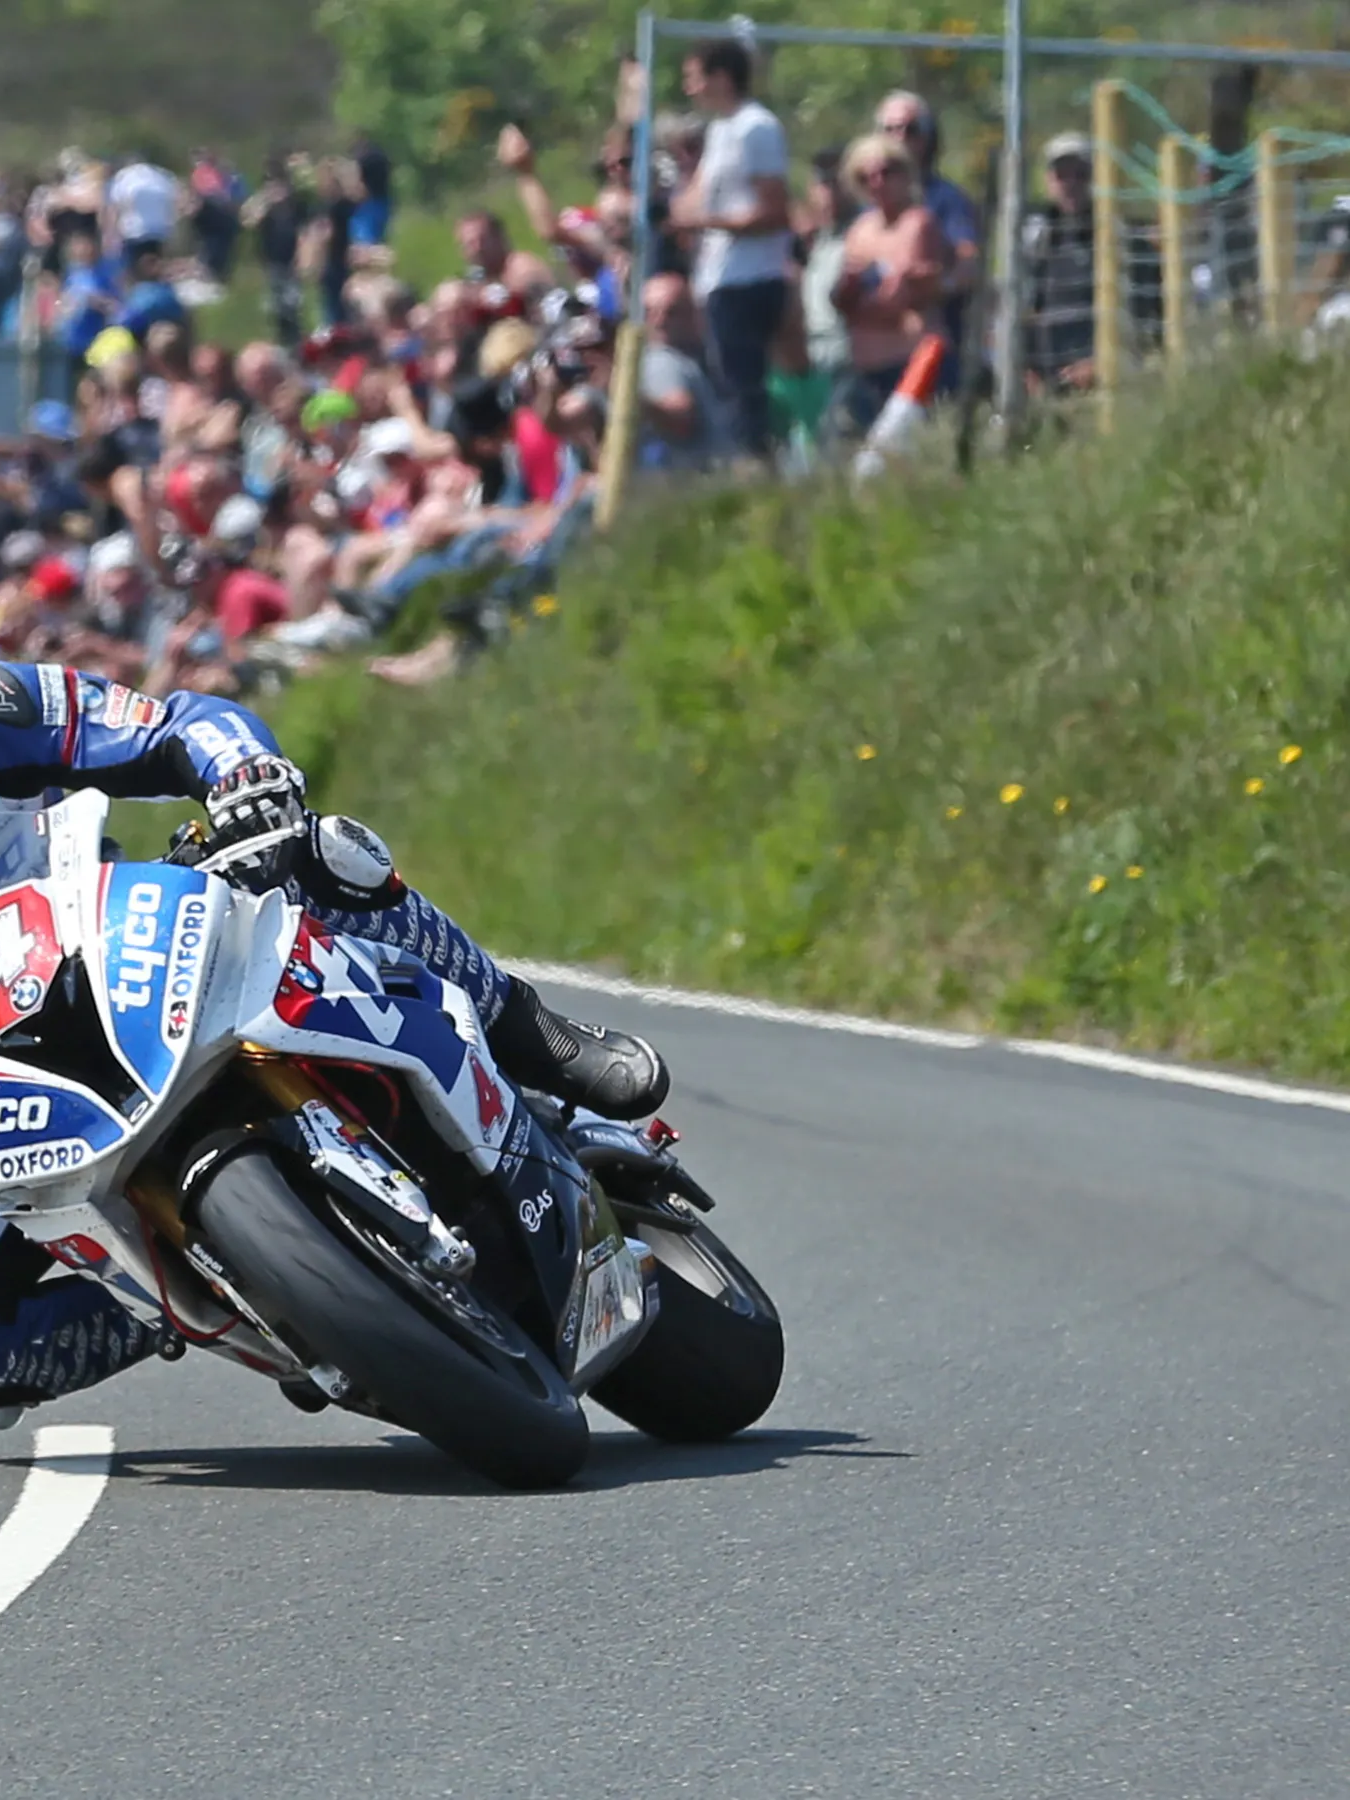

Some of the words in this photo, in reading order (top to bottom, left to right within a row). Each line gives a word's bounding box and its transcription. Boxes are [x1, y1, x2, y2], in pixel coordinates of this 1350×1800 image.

[109, 882, 167, 1014] tyco
[172, 901, 206, 997] OXFORD
[0, 1144, 85, 1179] OXFORD
